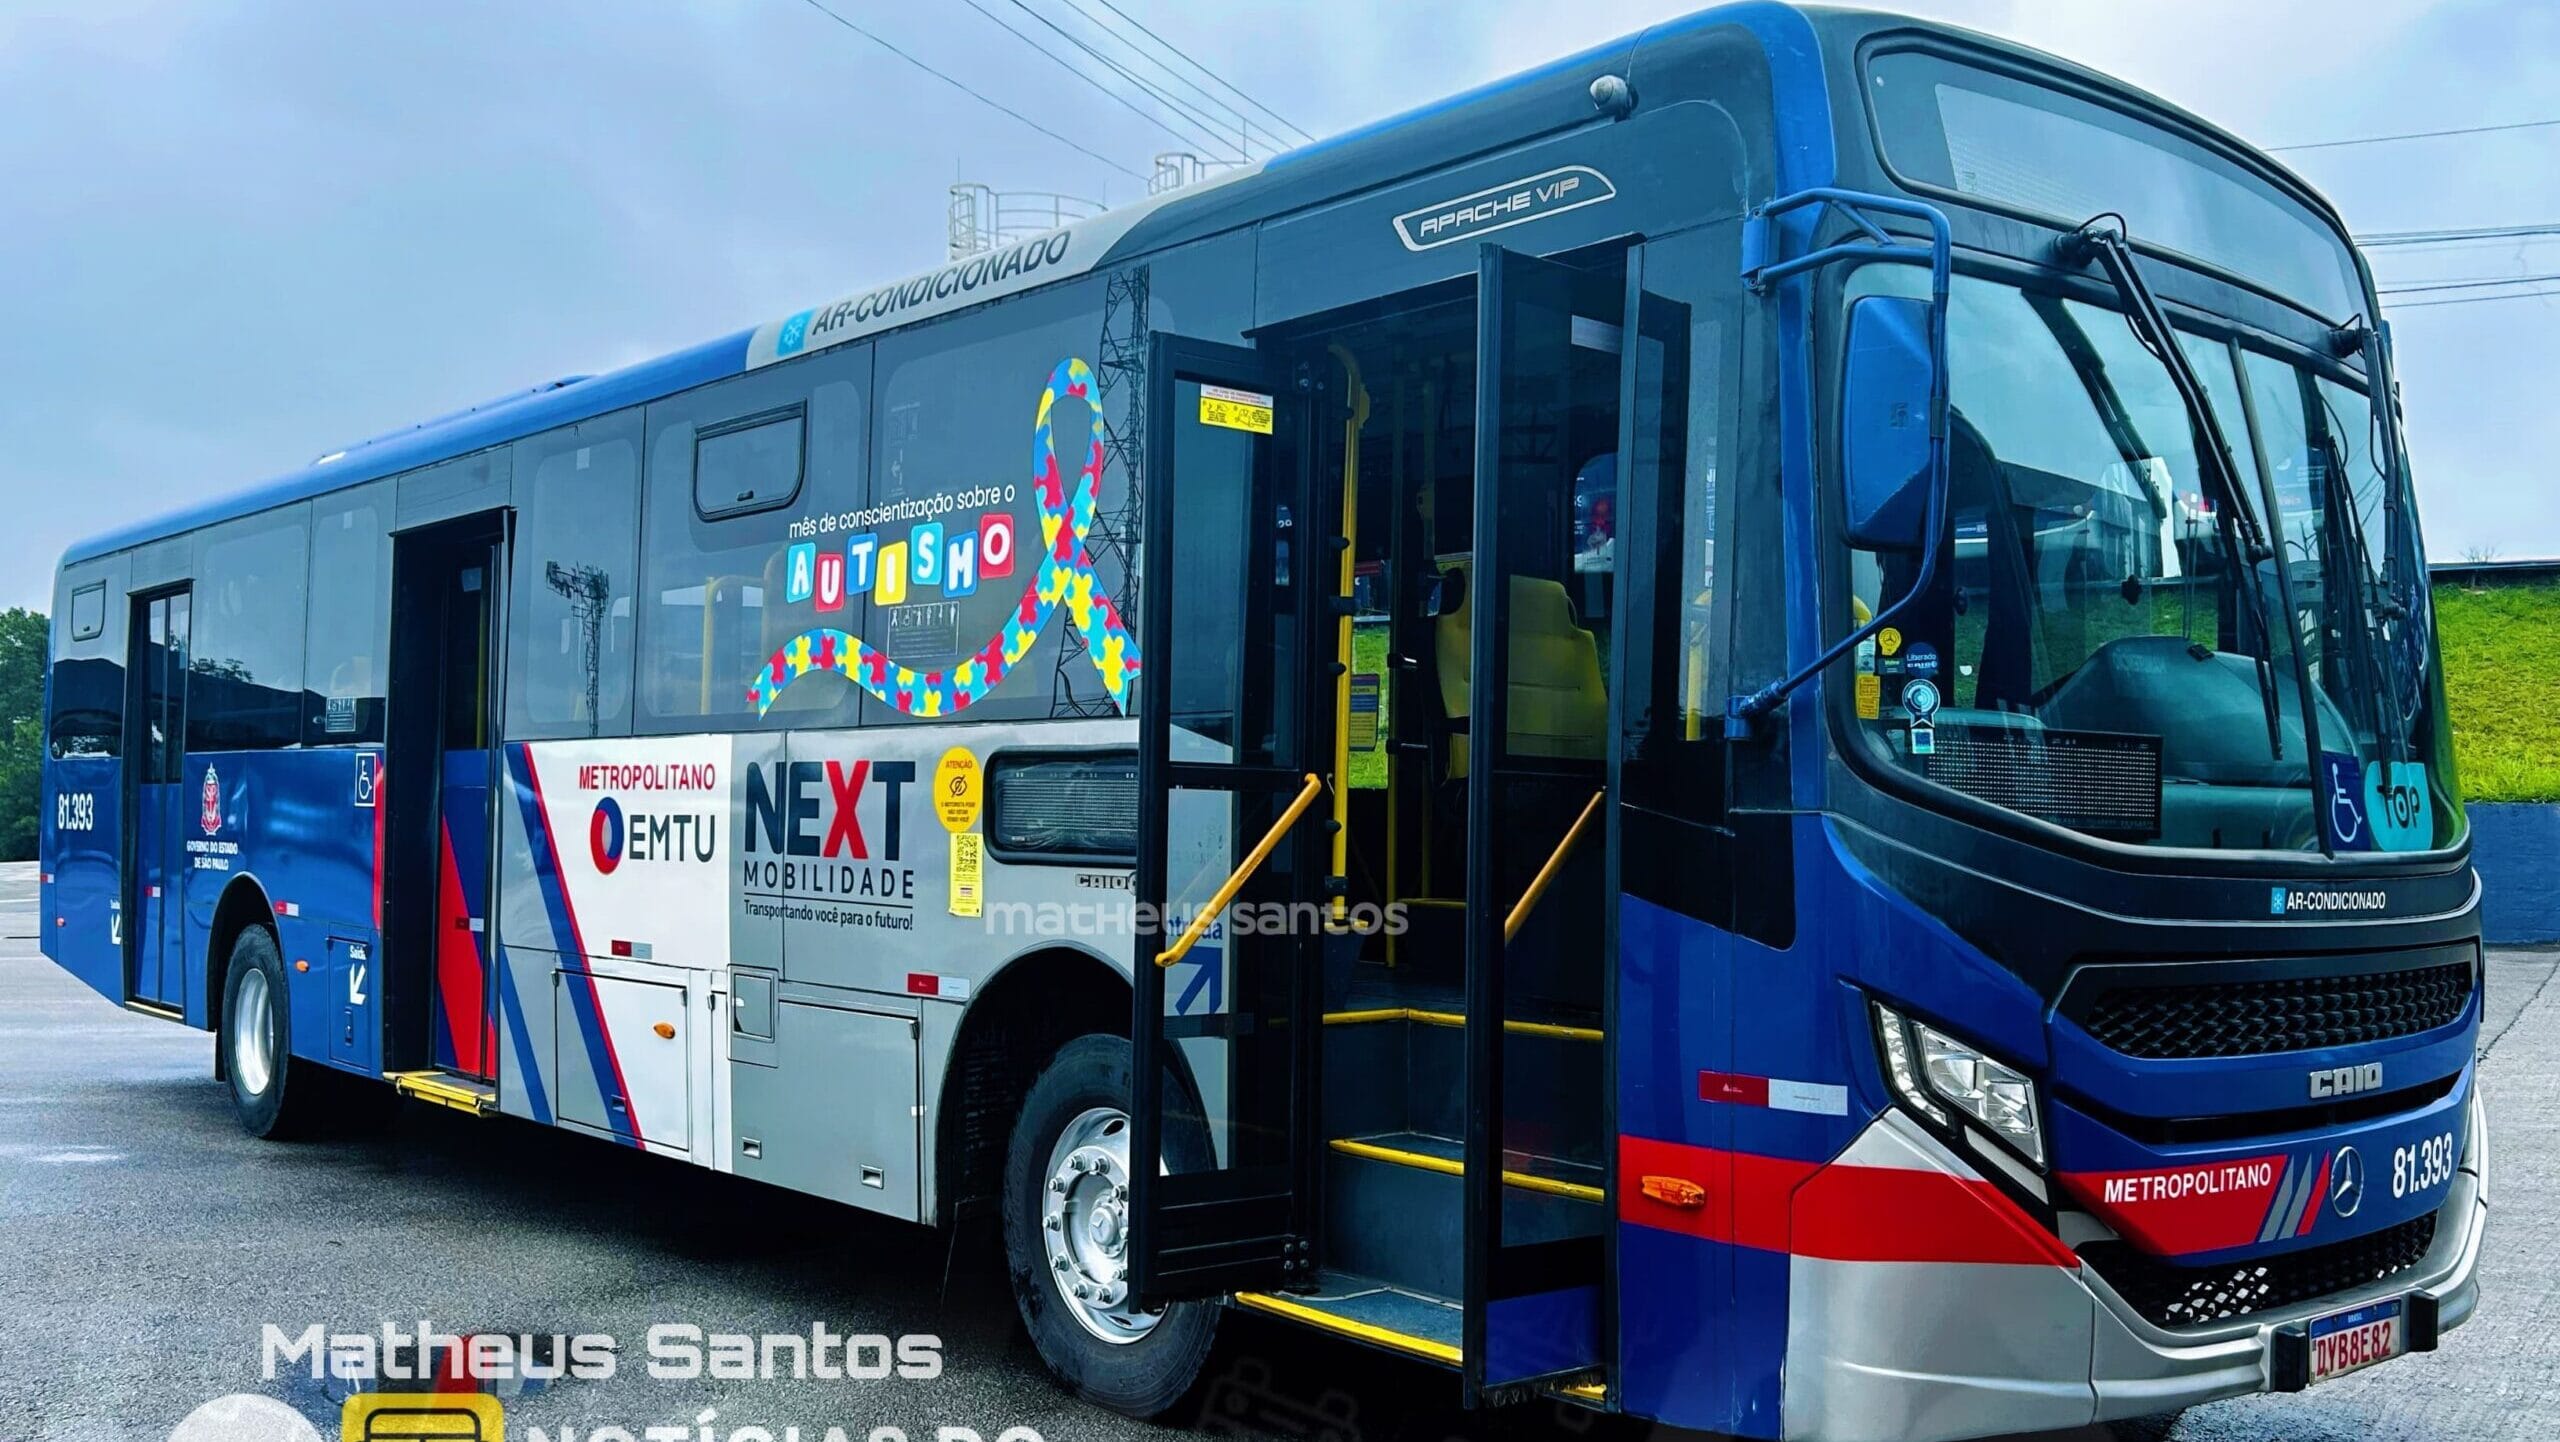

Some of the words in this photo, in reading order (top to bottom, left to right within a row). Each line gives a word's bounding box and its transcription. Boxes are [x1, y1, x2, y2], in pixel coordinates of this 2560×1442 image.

[1420, 191, 1531, 237] APACHE
[1536, 176, 1580, 203] VIP
[812, 231, 1071, 336] AR-CONDICIONADO
[789, 515, 817, 539] mês
[819, 512, 837, 532] de
[839, 493, 954, 530] conscientização
[957, 485, 1001, 510] sobre
[1004, 484, 1015, 502] o
[790, 520, 1011, 605] AUTISMO
[579, 764, 715, 791] METROPOLITANO
[57, 793, 94, 831] 81.393
[744, 760, 916, 861] NEXT
[629, 814, 716, 863] EMTU
[744, 861, 915, 899] MOBILIDADE
[2286, 891, 2387, 911] AR-CONDICIONADO
[744, 899, 813, 920] Transportando
[815, 906, 838, 923] você
[840, 912, 864, 927] para
[866, 915, 873, 926] o
[875, 911, 913, 931] futuro!
[2310, 1062, 2383, 1099] CAIO
[2104, 1163, 2272, 1203] METROPOLITANO
[2393, 1131, 2453, 1199] 81.393
[2316, 1320, 2391, 1377] DYB8E82
